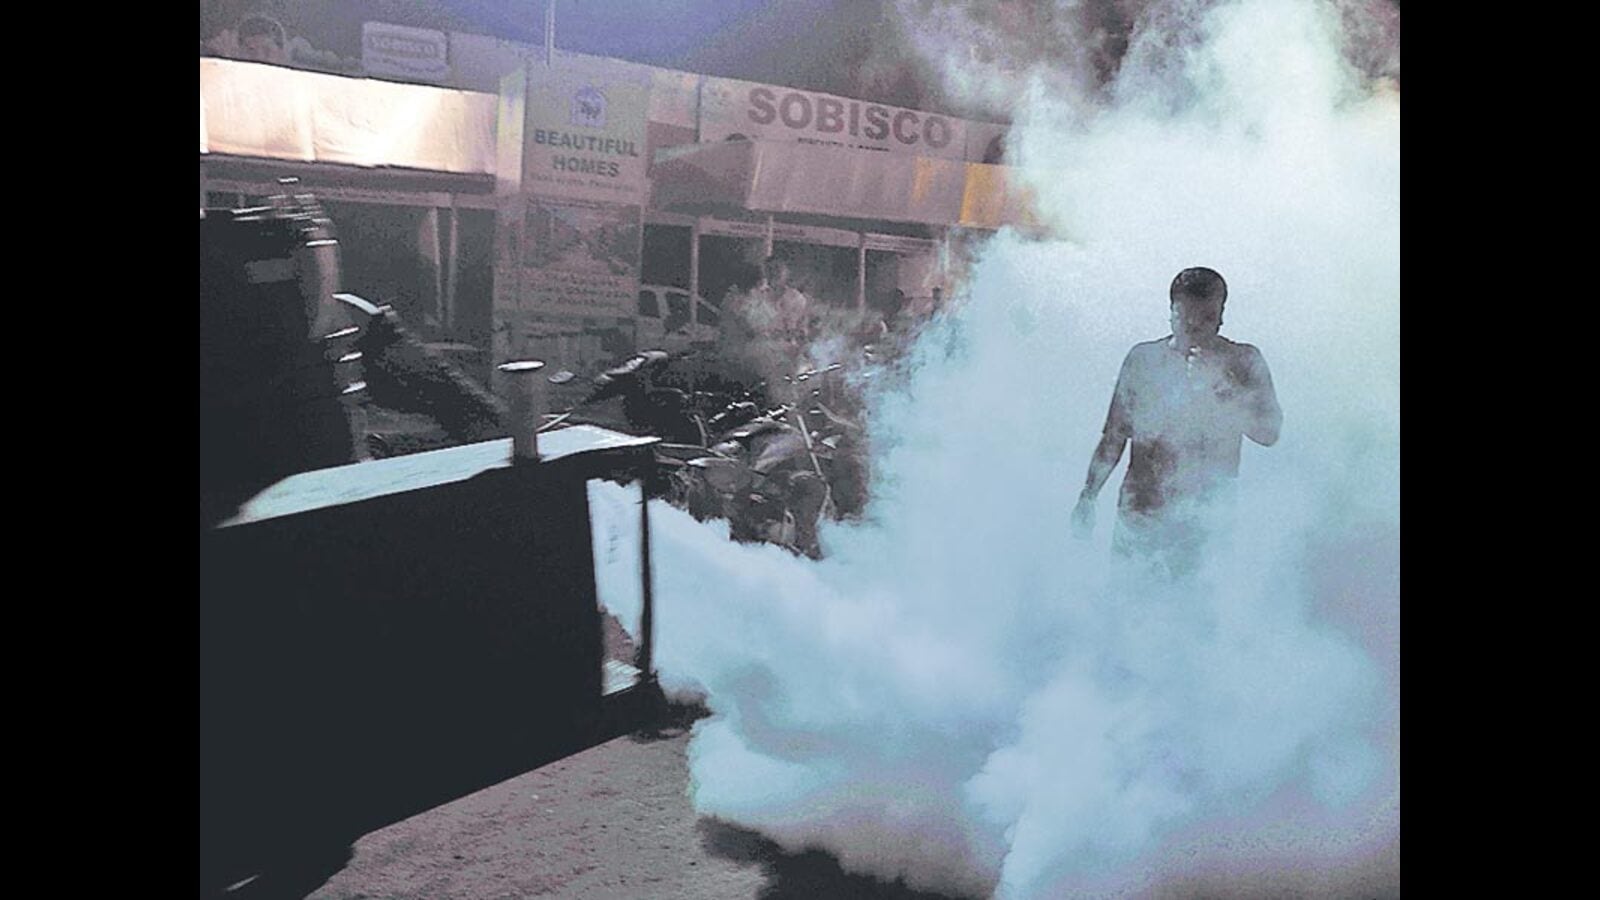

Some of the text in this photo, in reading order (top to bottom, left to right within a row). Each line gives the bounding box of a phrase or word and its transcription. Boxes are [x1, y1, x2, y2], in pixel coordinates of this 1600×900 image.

[747, 87, 953, 149] SOBISCO
[534, 128, 639, 158] BEAUTIFUL
[552, 154, 621, 178] HOMES
